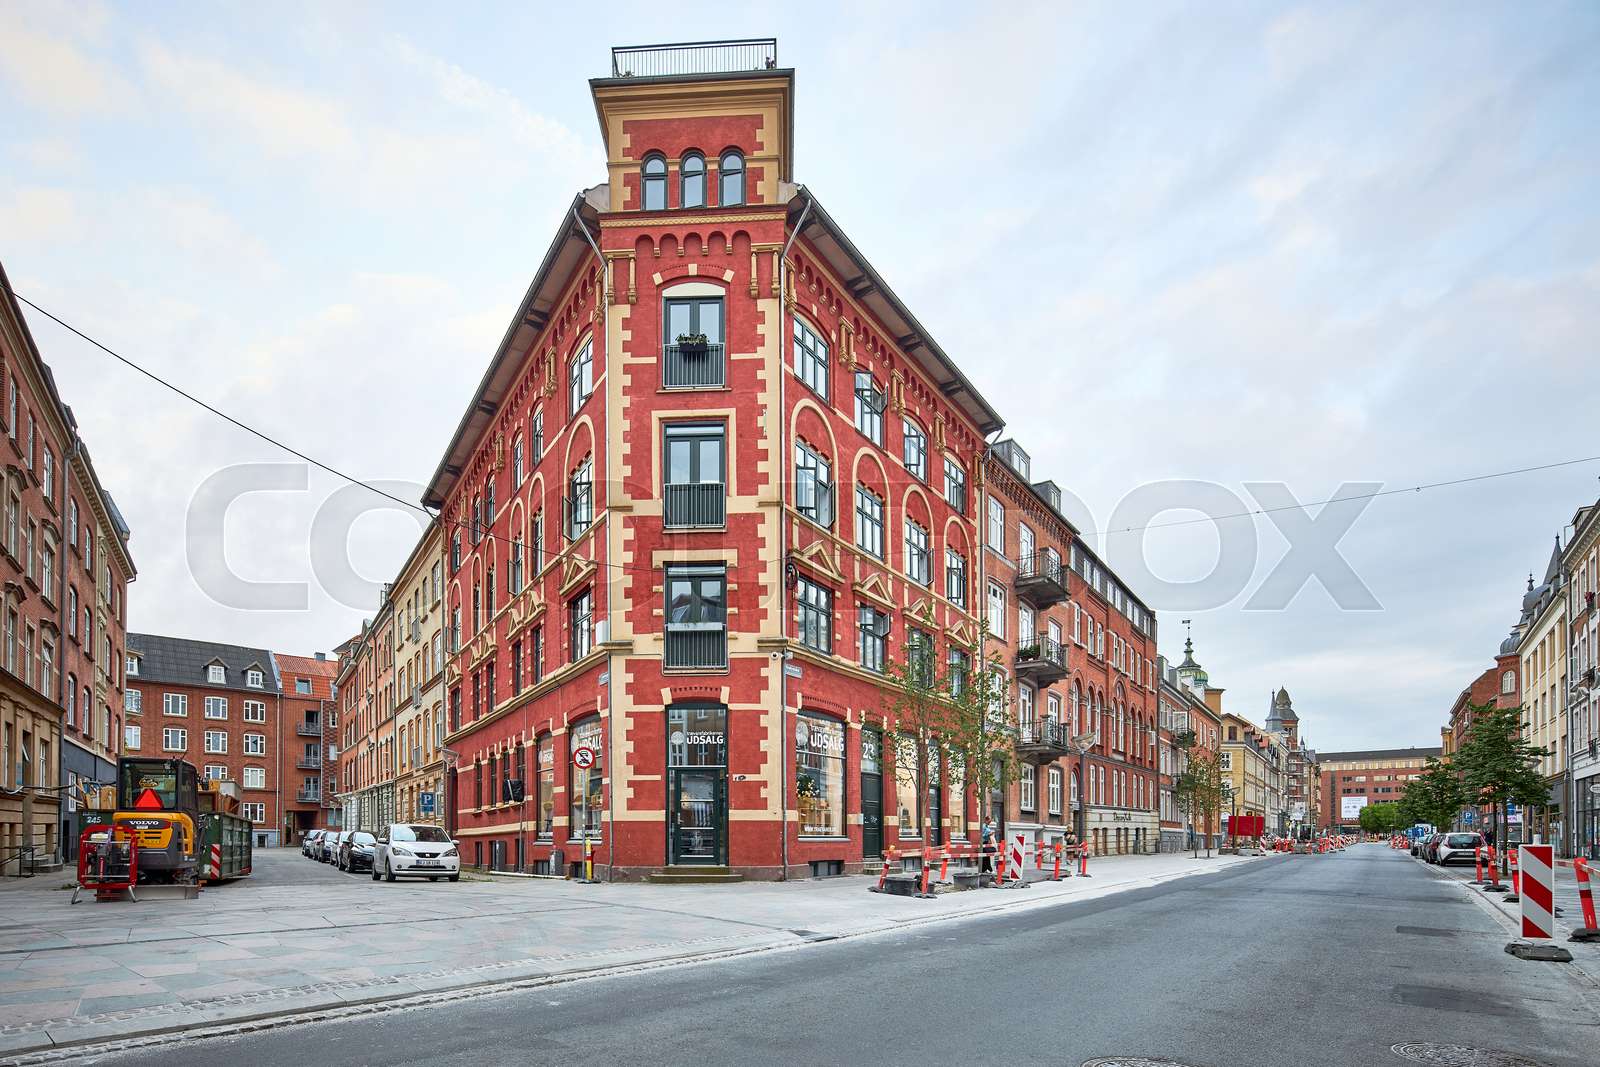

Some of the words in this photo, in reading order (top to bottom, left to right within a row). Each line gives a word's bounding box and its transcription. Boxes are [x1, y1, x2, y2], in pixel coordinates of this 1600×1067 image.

[687, 736, 723, 744] UDSALG
[811, 732, 844, 751] UDSALG
[863, 743, 875, 759] 23
[424, 794, 432, 804] P
